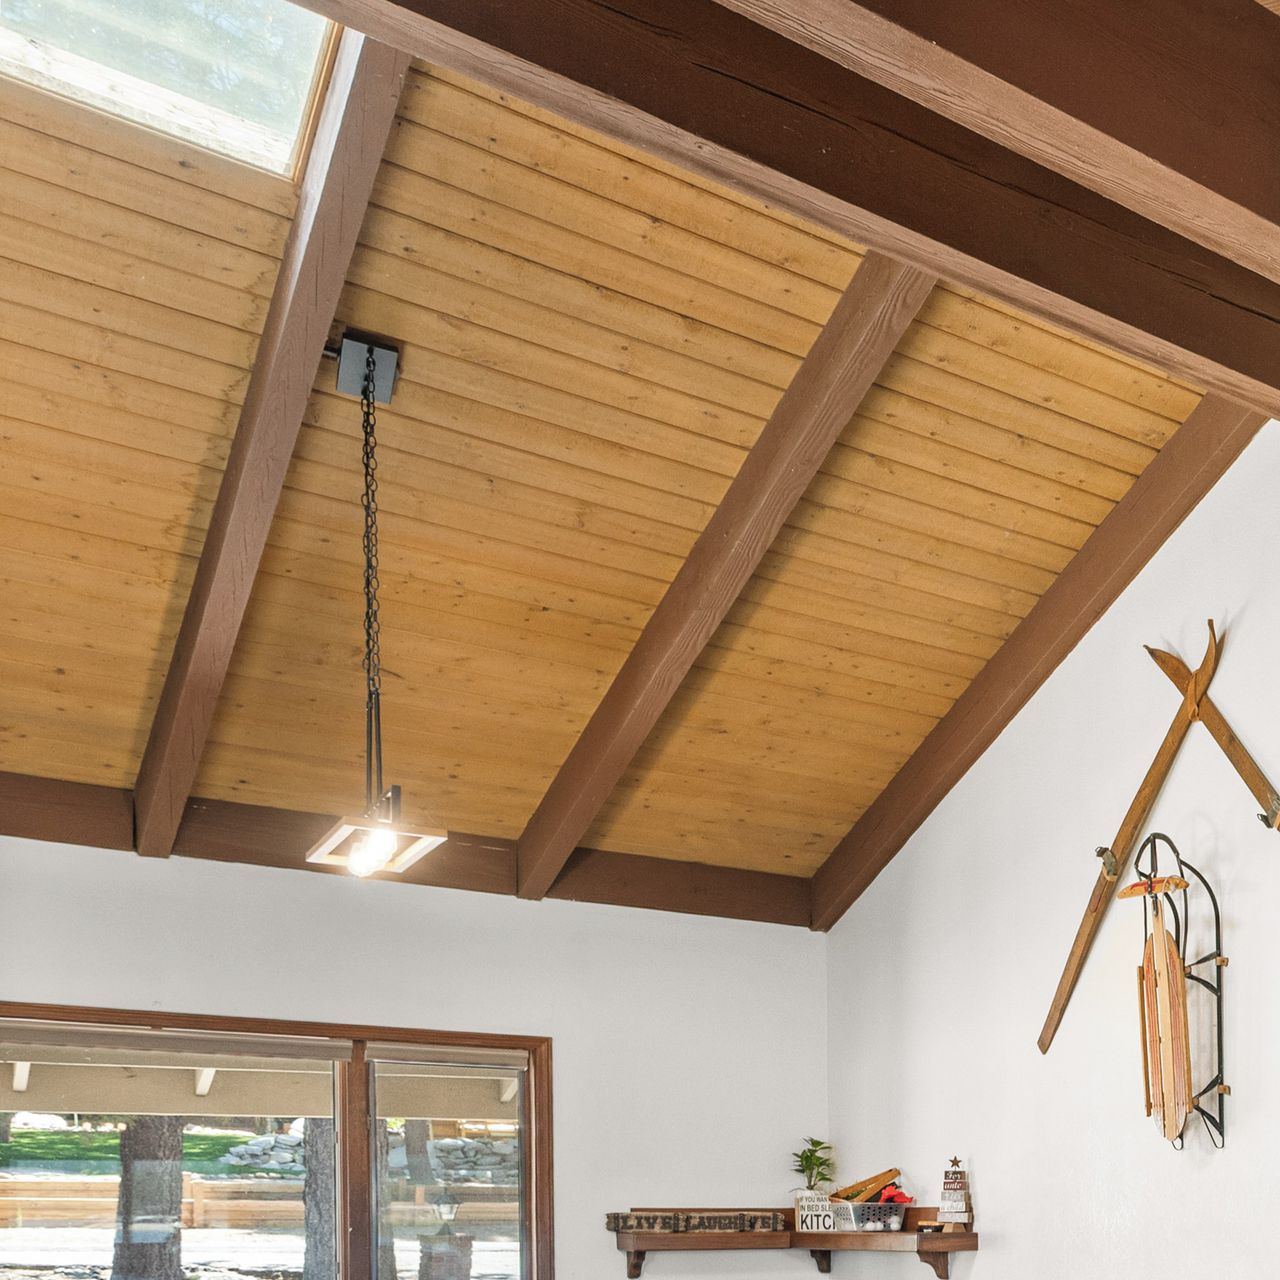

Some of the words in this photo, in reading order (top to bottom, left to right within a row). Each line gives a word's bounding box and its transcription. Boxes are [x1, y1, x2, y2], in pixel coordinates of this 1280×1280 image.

[620, 1215, 674, 1230] LIVE
[686, 1214, 740, 1230] LAUGH
[801, 1214, 835, 1230] KITC
